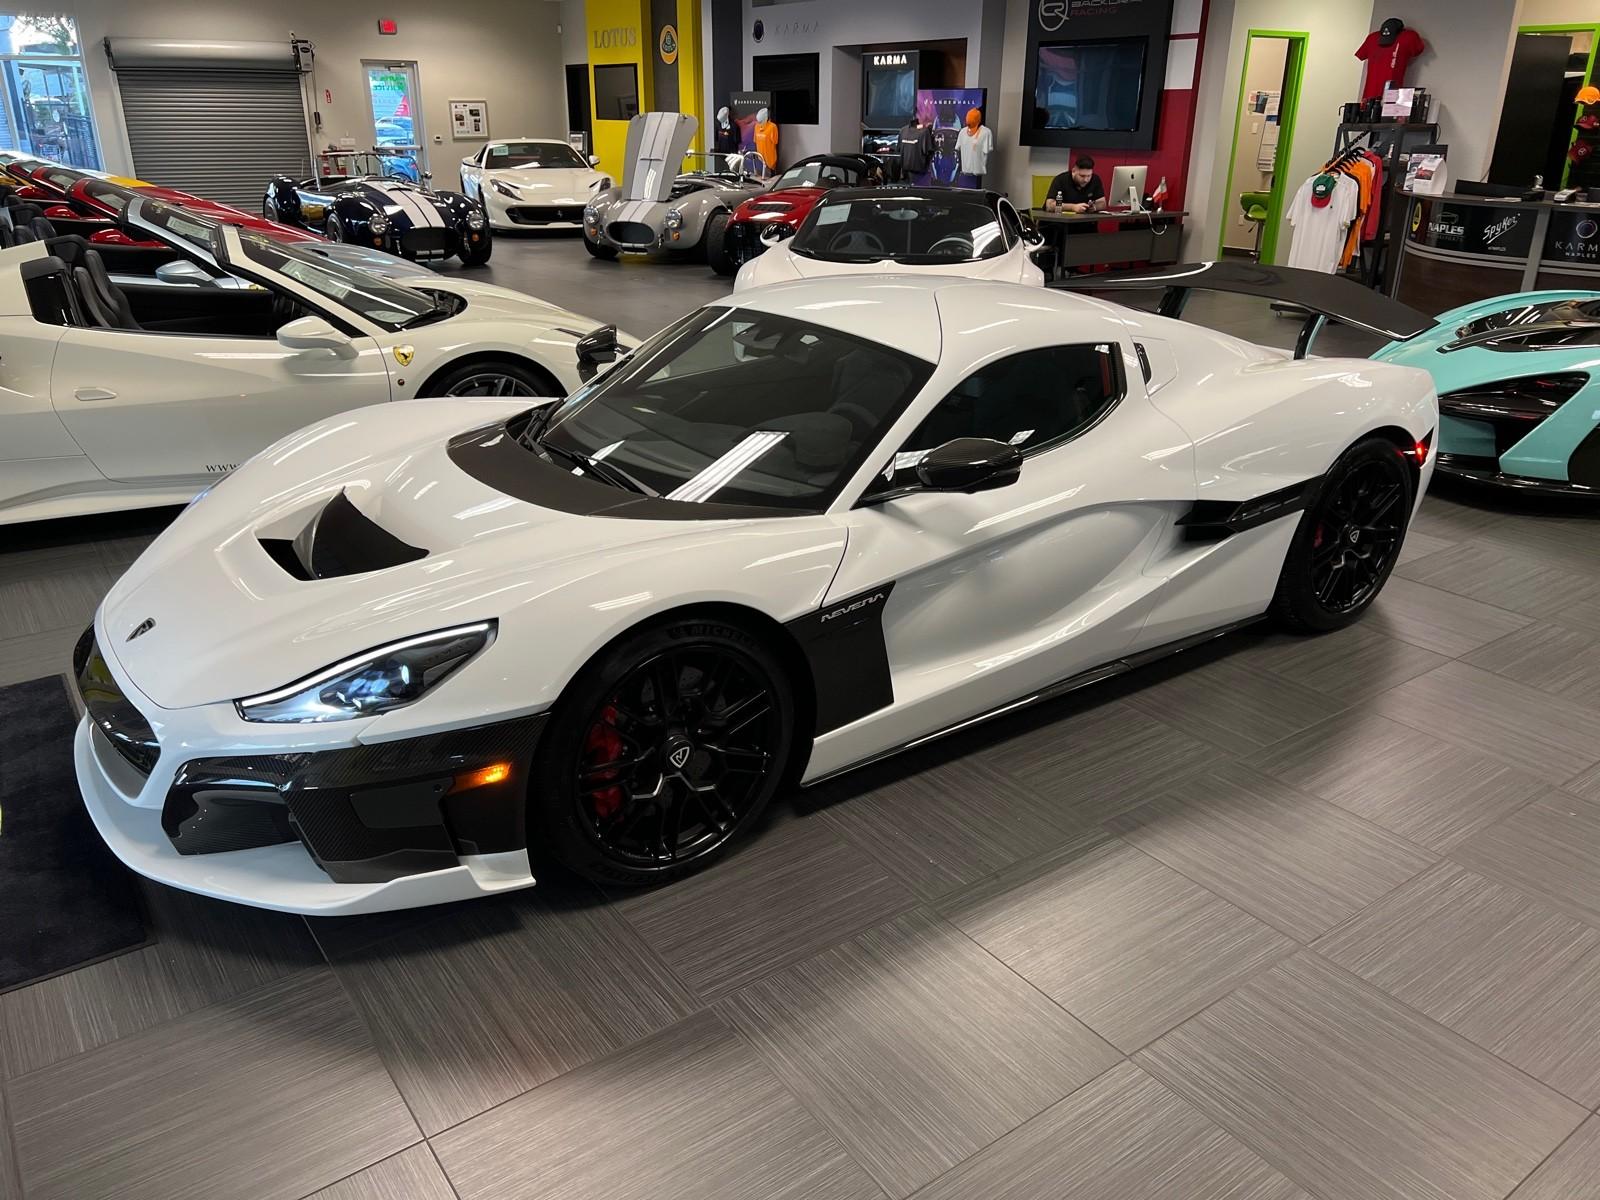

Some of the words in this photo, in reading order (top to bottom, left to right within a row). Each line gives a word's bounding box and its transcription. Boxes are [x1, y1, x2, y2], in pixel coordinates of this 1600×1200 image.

[1072, 0, 1142, 8] BACKD
[1071, 6, 1119, 16] RACING
[593, 26, 637, 49] LOTUS
[873, 54, 908, 66] KARMA
[1428, 222, 1465, 236] NAPLES
[820, 593, 884, 623] NEVERA
